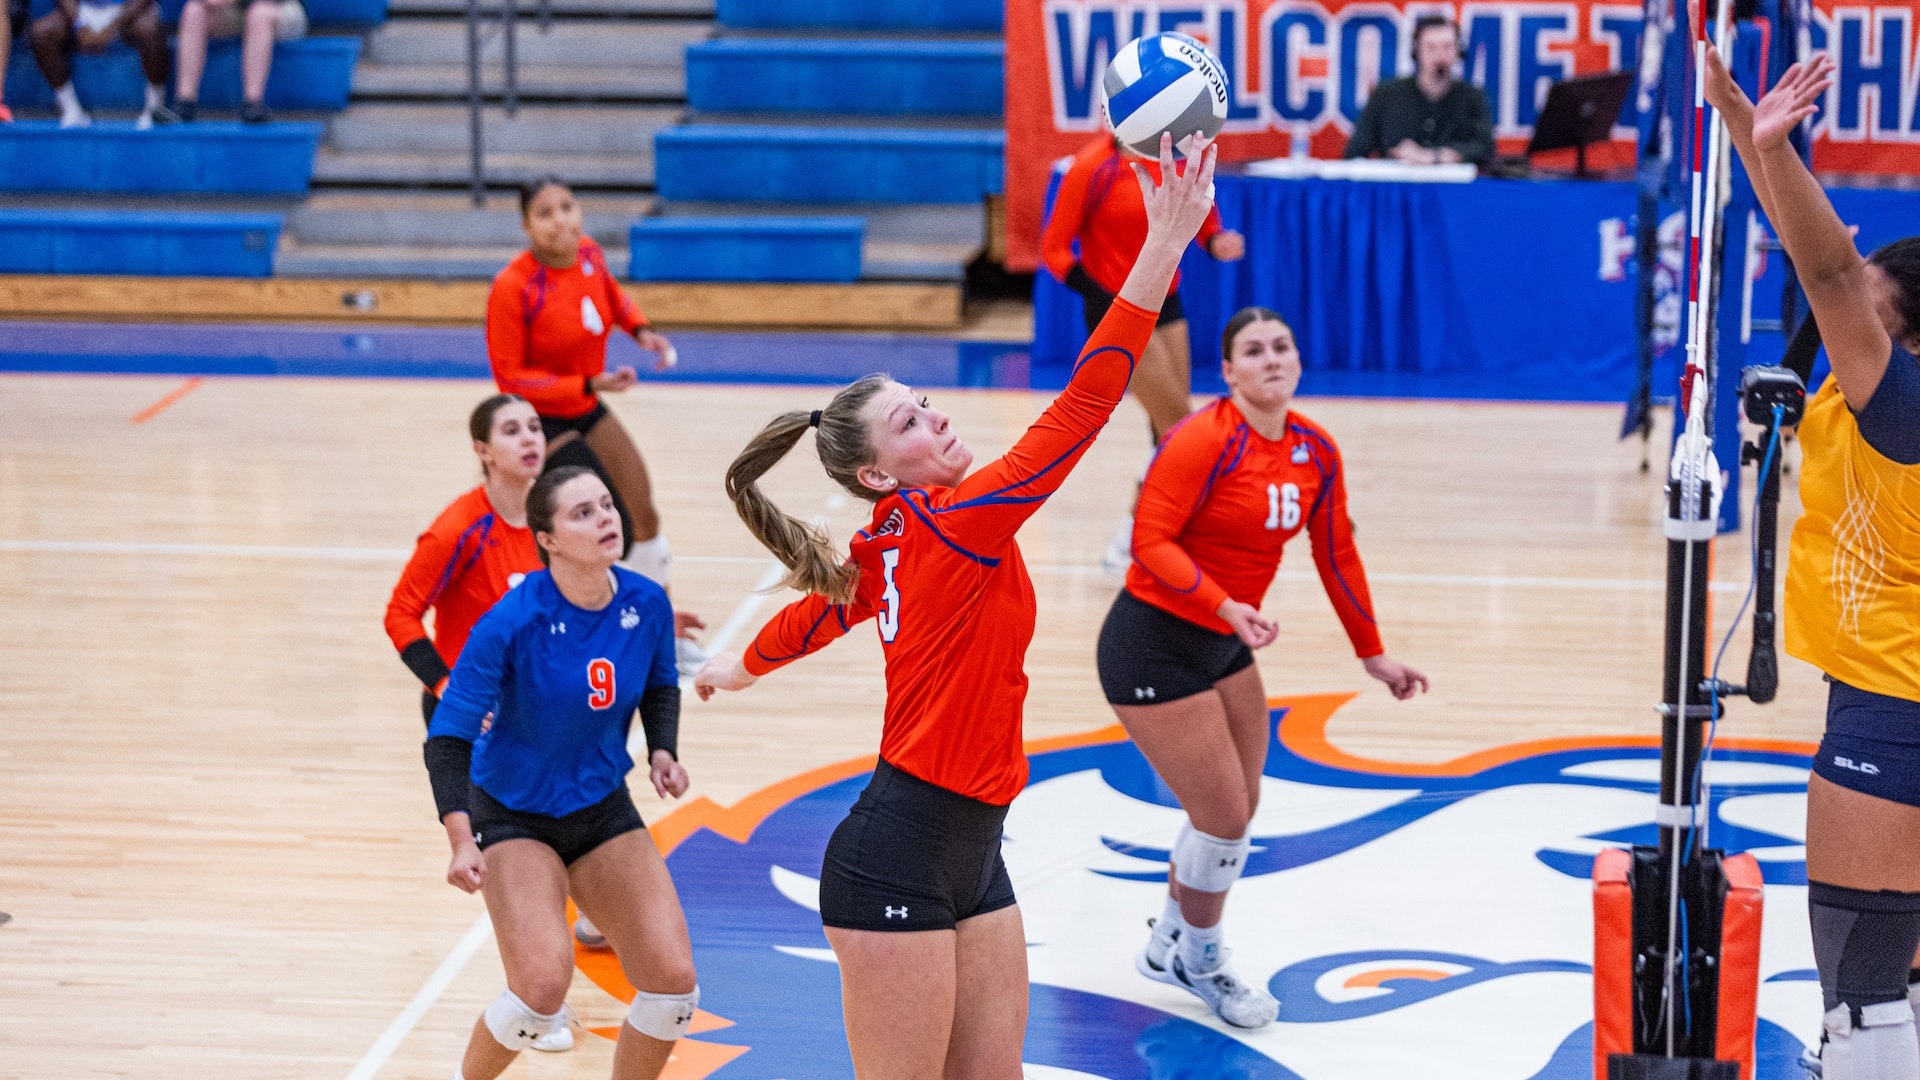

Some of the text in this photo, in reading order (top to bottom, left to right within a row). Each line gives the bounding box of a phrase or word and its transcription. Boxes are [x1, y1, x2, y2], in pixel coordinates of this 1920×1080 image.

[1179, 45, 1225, 103] molten
[1264, 483, 1301, 529] 16
[879, 547, 900, 643] 5
[587, 657, 616, 710] 9
